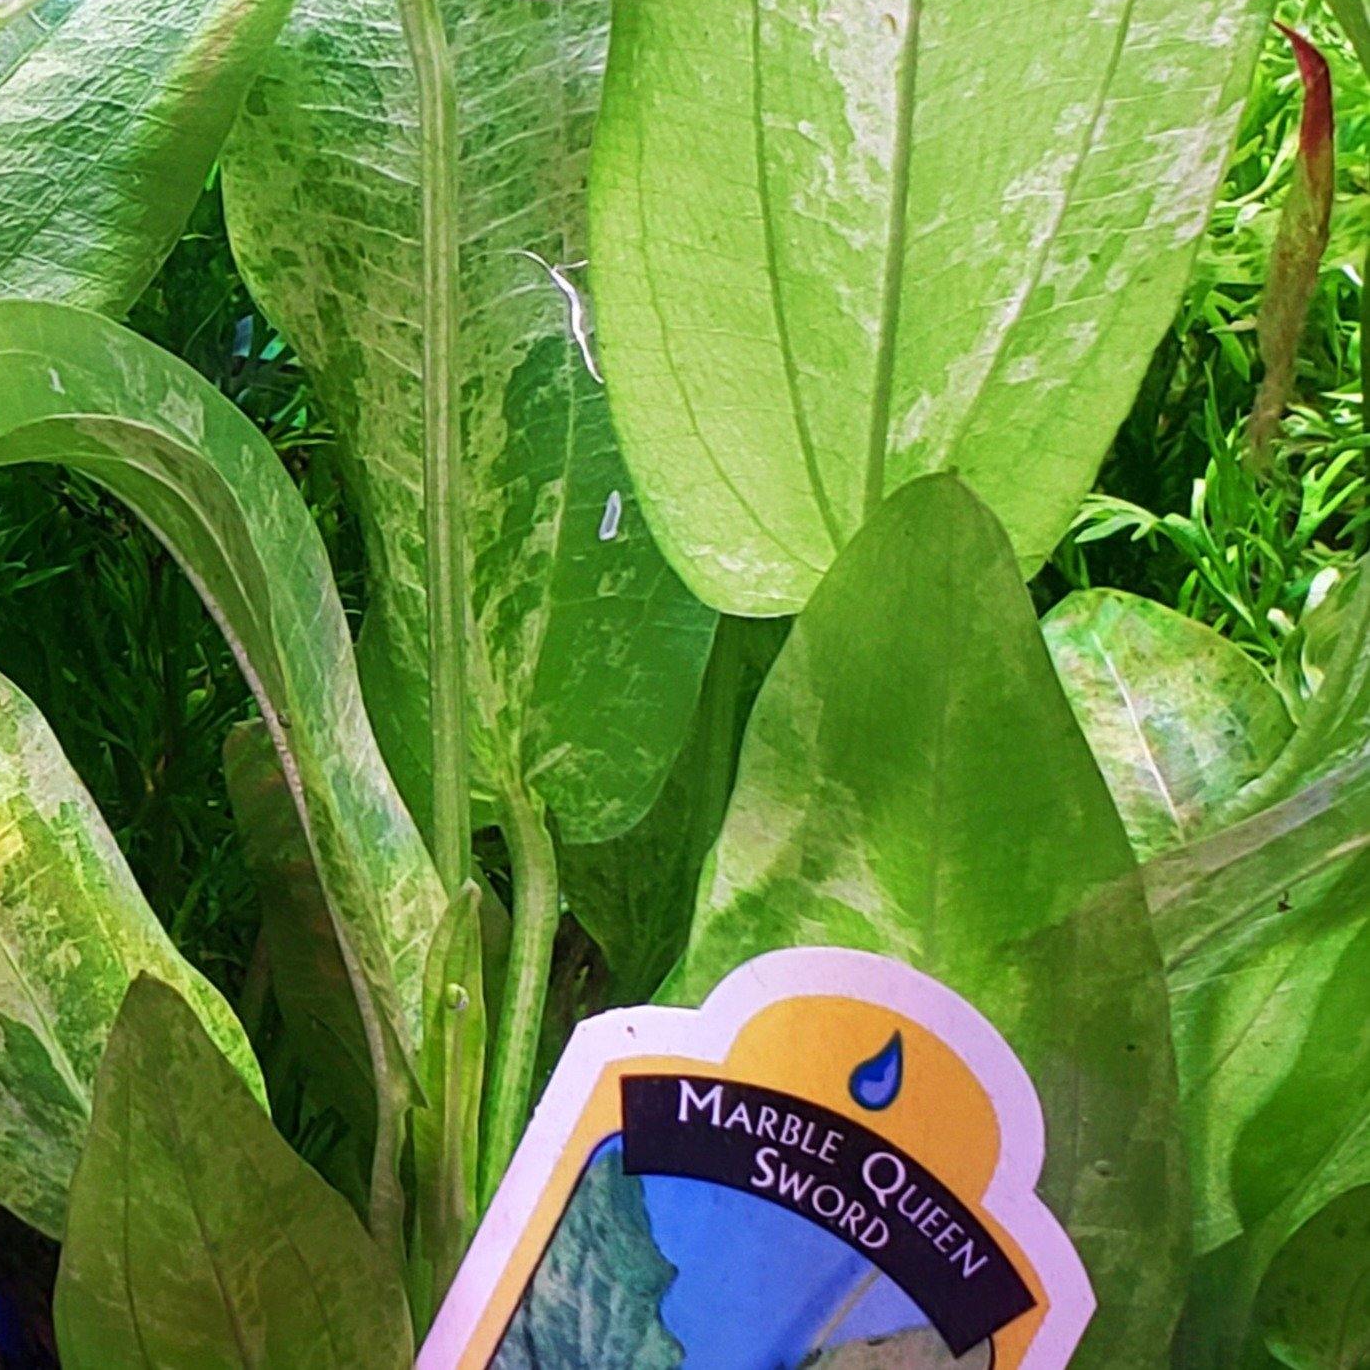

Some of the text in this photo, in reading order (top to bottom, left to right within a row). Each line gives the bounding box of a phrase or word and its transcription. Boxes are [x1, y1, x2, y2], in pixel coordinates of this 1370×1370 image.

[677, 1079, 988, 1279] MARBLE QUEEN
[750, 1147, 889, 1249] SWORD
